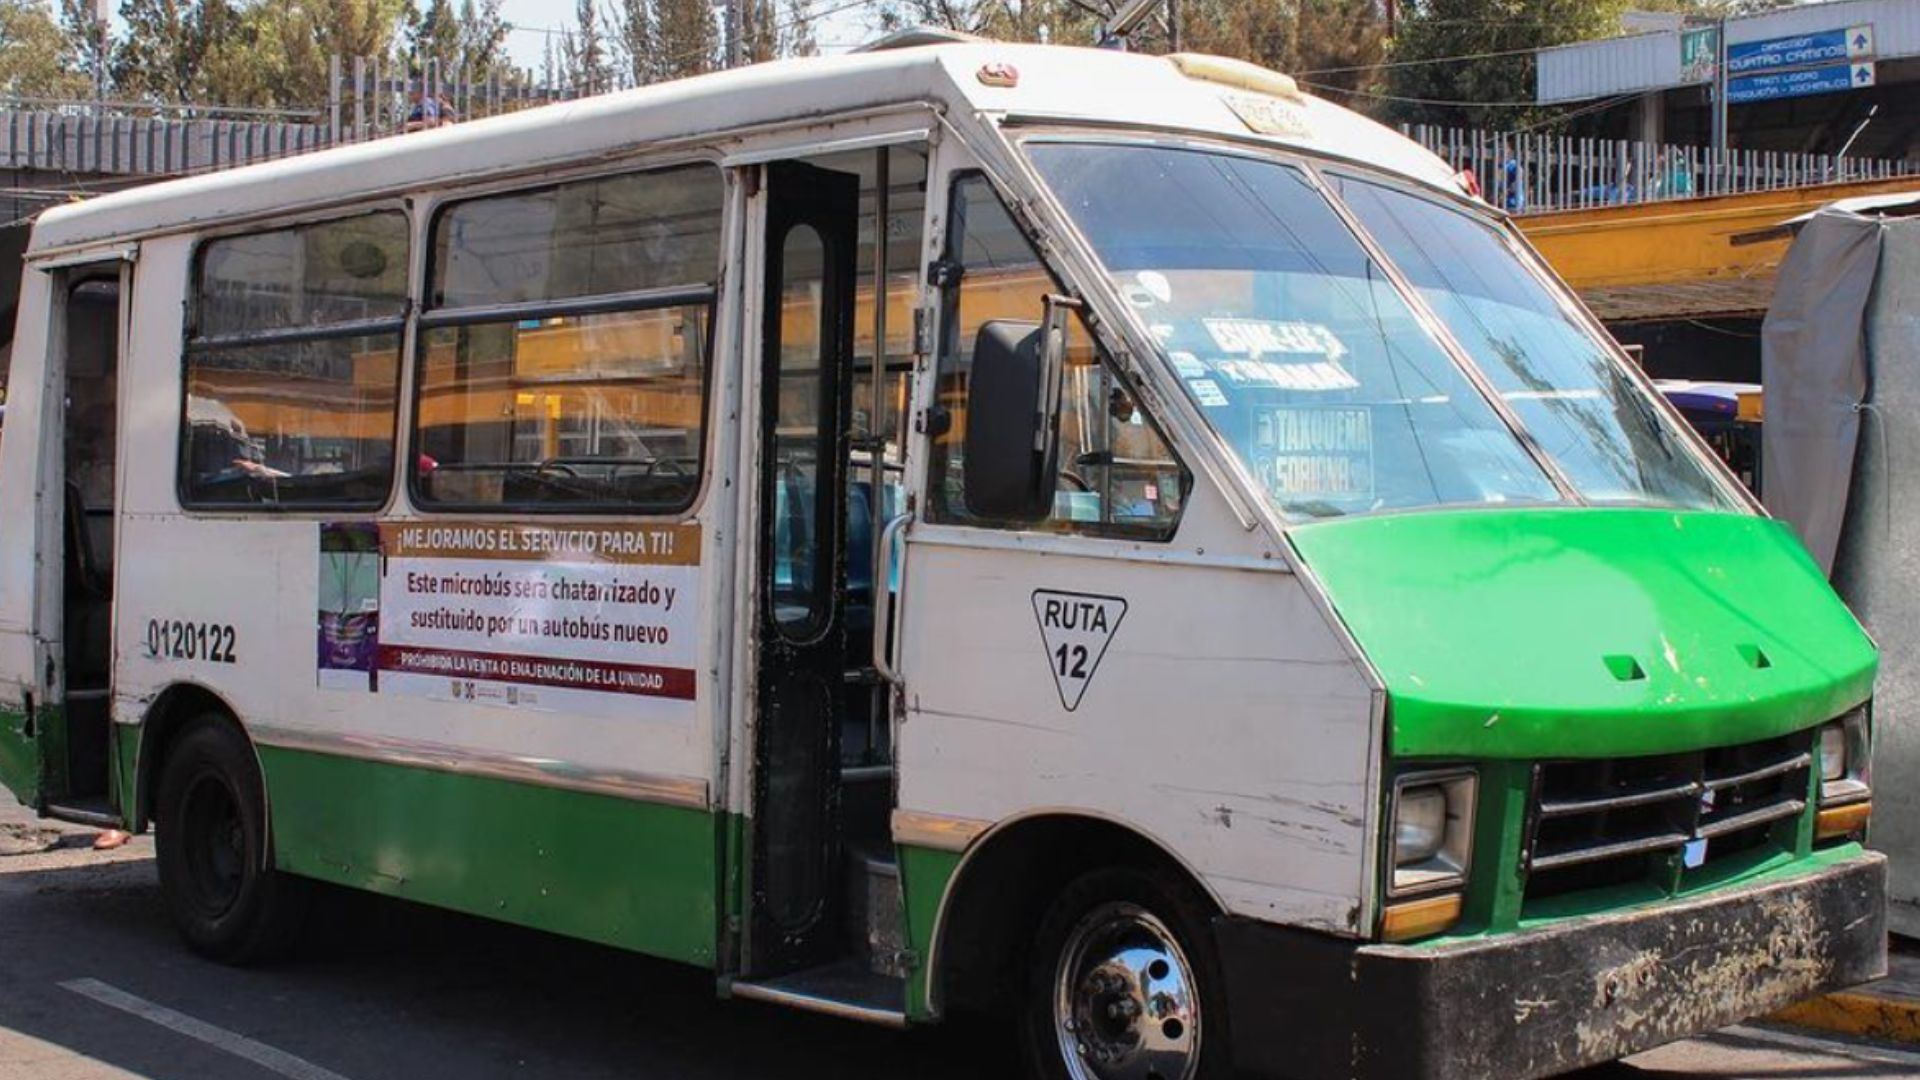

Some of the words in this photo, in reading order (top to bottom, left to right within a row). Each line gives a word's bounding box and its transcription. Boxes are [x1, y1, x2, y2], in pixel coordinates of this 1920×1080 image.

[1728, 53, 1781, 70] CUATRO
[1785, 45, 1847, 62] CAMINOS
[397, 528, 496, 552] ¡MEJORAMOS
[500, 530, 518, 550] EL
[521, 529, 597, 552] SERVICIO
[601, 531, 646, 555] PARA
[650, 531, 674, 555] TI!
[407, 572, 438, 593] Este
[441, 571, 512, 597] microbús
[514, 572, 548, 599] será
[664, 586, 676, 611] y
[411, 607, 484, 632] sustituido
[487, 614, 513, 637] por
[519, 617, 539, 635] un
[543, 615, 610, 642] autobús
[614, 623, 669, 645] nuevo
[1045, 599, 1108, 634] RUTA
[147, 618, 236, 663] 0120122
[453, 656, 467, 671] LA
[467, 658, 499, 674] VENTA
[501, 661, 510, 675] O
[511, 663, 584, 682] ENAJENACIÓN
[586, 667, 601, 683] DE
[602, 669, 618, 686] LA
[619, 671, 664, 690] UNIDAD
[1056, 642, 1089, 679] 12
